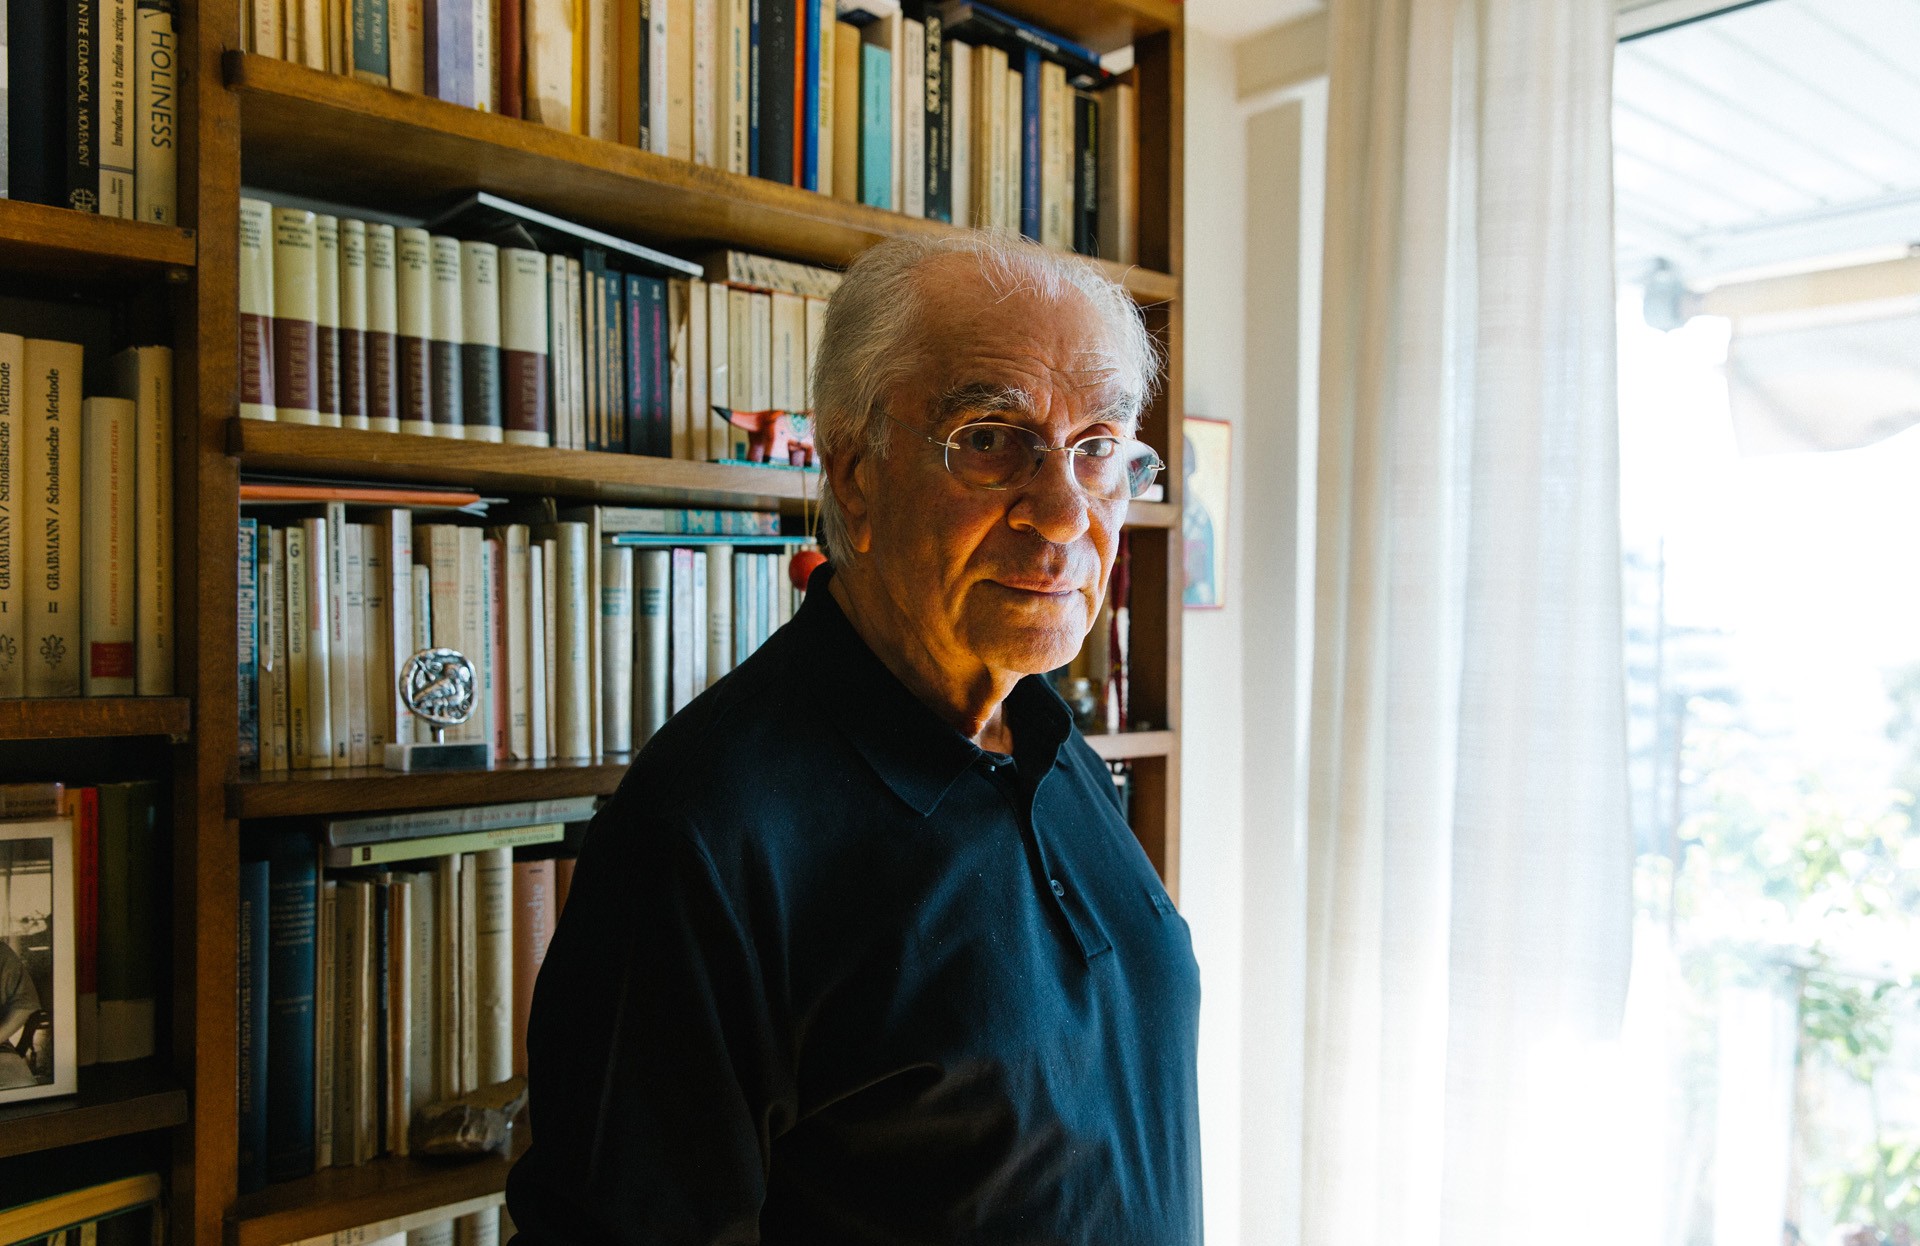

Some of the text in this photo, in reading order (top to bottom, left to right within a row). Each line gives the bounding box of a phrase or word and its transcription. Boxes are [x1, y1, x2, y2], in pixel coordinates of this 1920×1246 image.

[78, 17, 90, 37] THE
[112, 6, 127, 42] ascétique
[78, 38, 90, 103] ECUMENICAL
[111, 44, 124, 79] tradition
[151, 29, 171, 150] HOLINESS
[77, 106, 90, 168] MOVEMENT
[111, 99, 124, 147] Introduction
[0, 362, 11, 416] Methode
[45, 367, 60, 422] Methode
[0, 422, 11, 502] Scholastische
[45, 426, 60, 505] Scholastische
[0, 516, 11, 590] GRABMANN
[46, 516, 60, 591] GRABMANN
[525, 884, 544, 964] nietzsche
